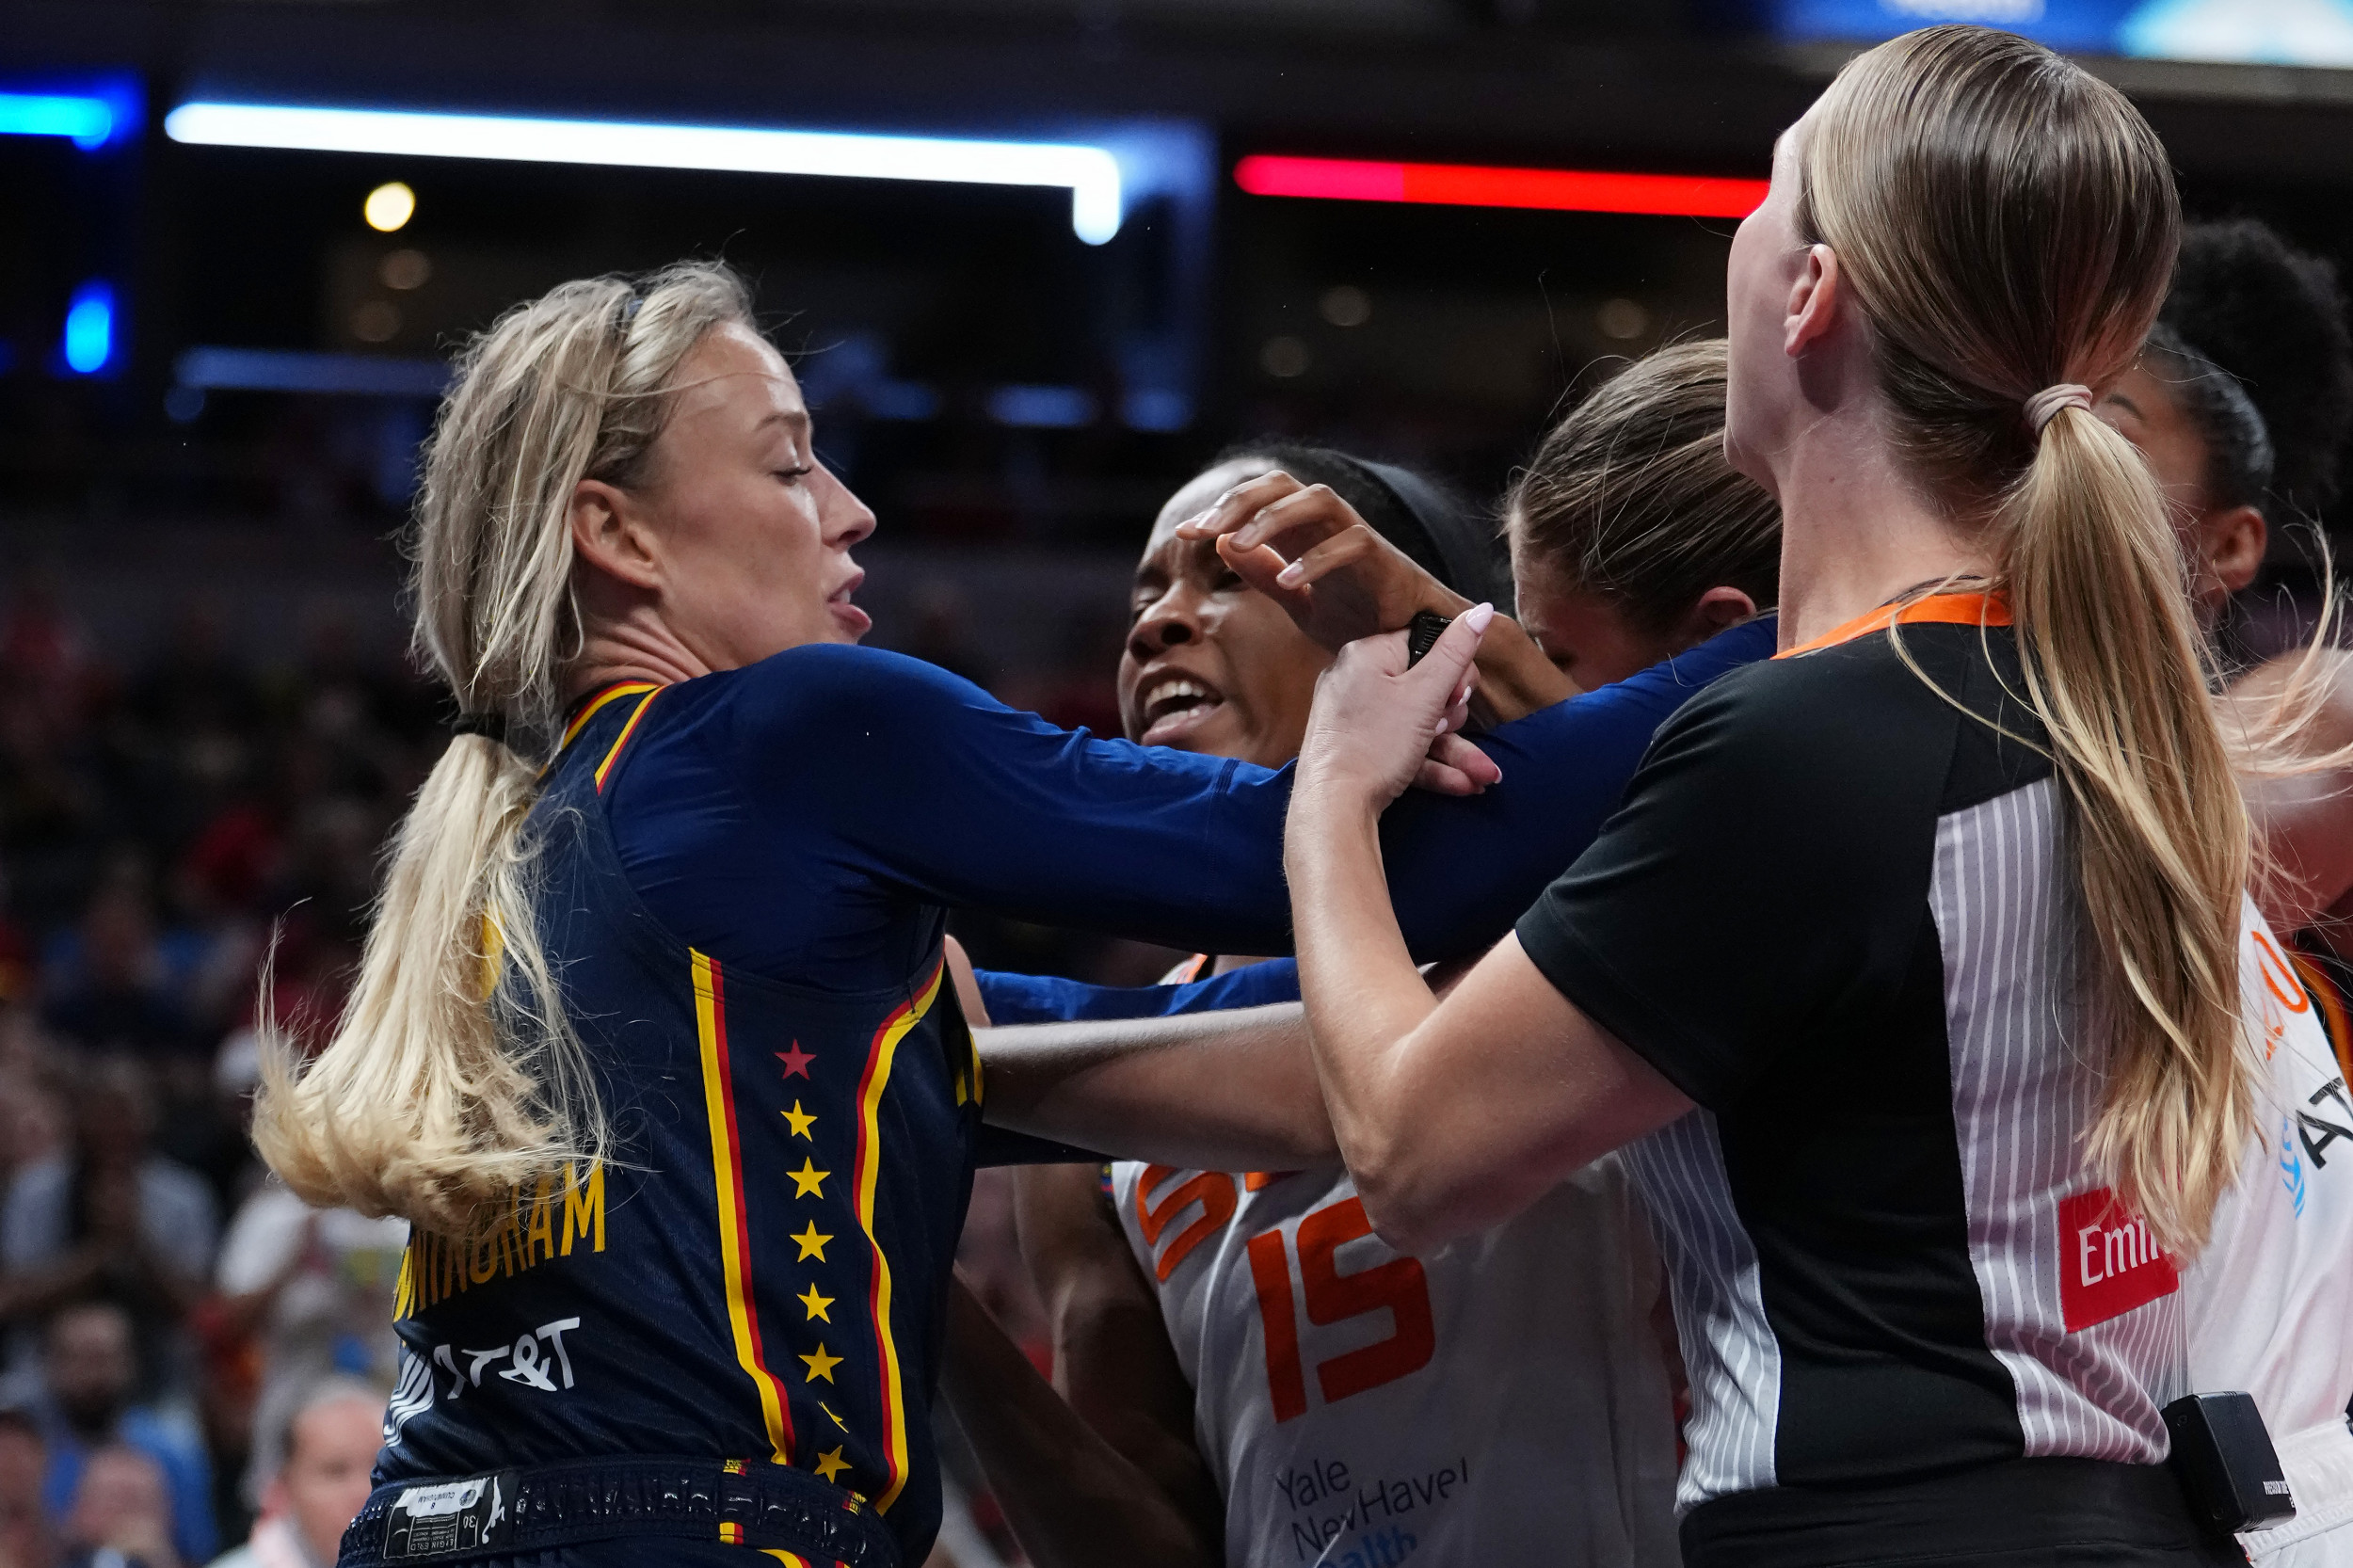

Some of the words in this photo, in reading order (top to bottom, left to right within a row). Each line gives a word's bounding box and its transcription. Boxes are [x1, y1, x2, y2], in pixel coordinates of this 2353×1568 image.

[1248, 1195, 1436, 1424] 15
[1276, 1457, 1351, 1511] Yale
[462, 1515, 476, 1528] 30
